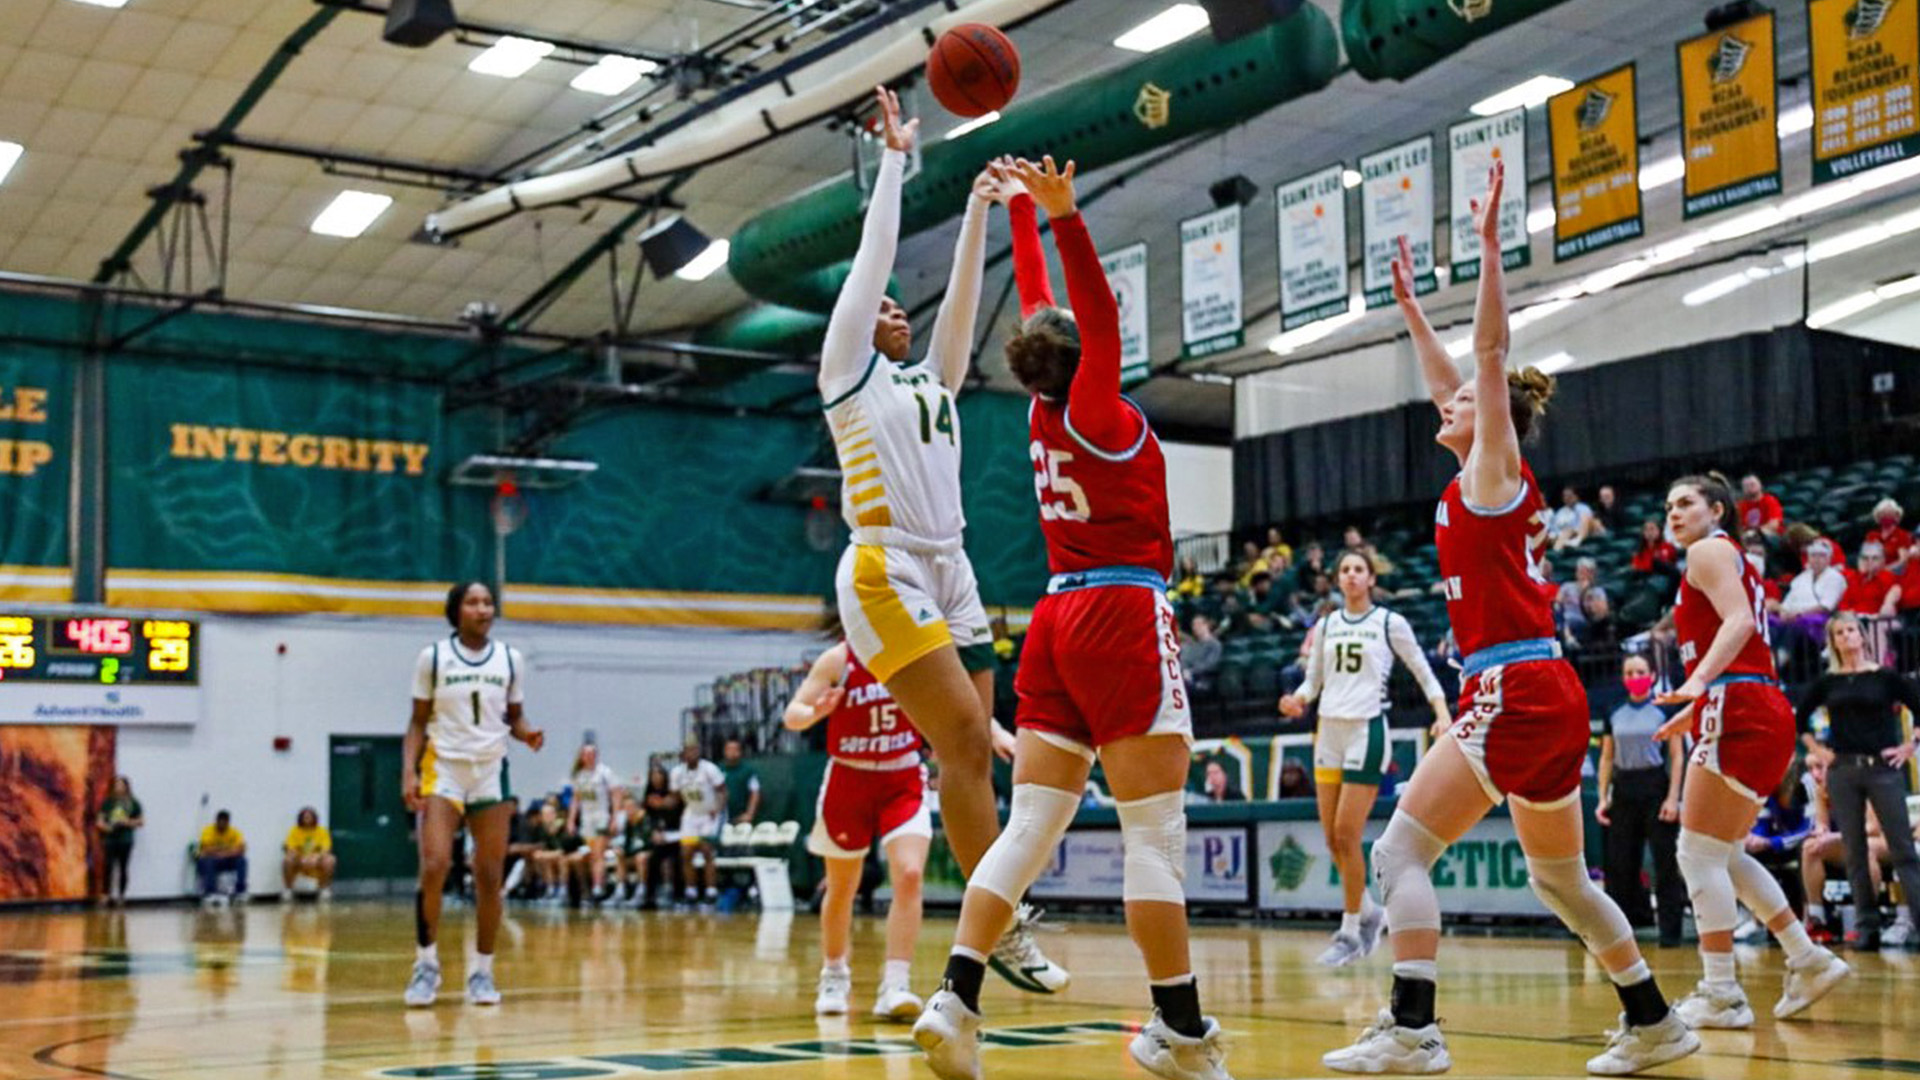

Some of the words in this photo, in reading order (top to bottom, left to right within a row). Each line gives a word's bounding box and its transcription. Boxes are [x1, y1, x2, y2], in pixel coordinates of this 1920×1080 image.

[1823, 65, 1910, 102] TOURNAMENT
[1834, 54, 1895, 83] REGIONAL
[1690, 106, 1766, 140] TOURNAMENT
[1700, 96, 1755, 123] REGIONAL
[1455, 126, 1492, 149] SAINT
[1496, 115, 1521, 138] LEO
[1364, 156, 1401, 181] SAINT
[1404, 147, 1427, 168] LEO
[1830, 141, 1905, 175] VOLLEYBALL
[913, 391, 955, 446] 14
[170, 424, 428, 475] INTEGRITY
[1029, 439, 1091, 522] 25
[101, 657, 119, 684] 2
[1335, 643, 1363, 673] 15
[471, 690, 480, 725] 1
[869, 703, 898, 734] 15
